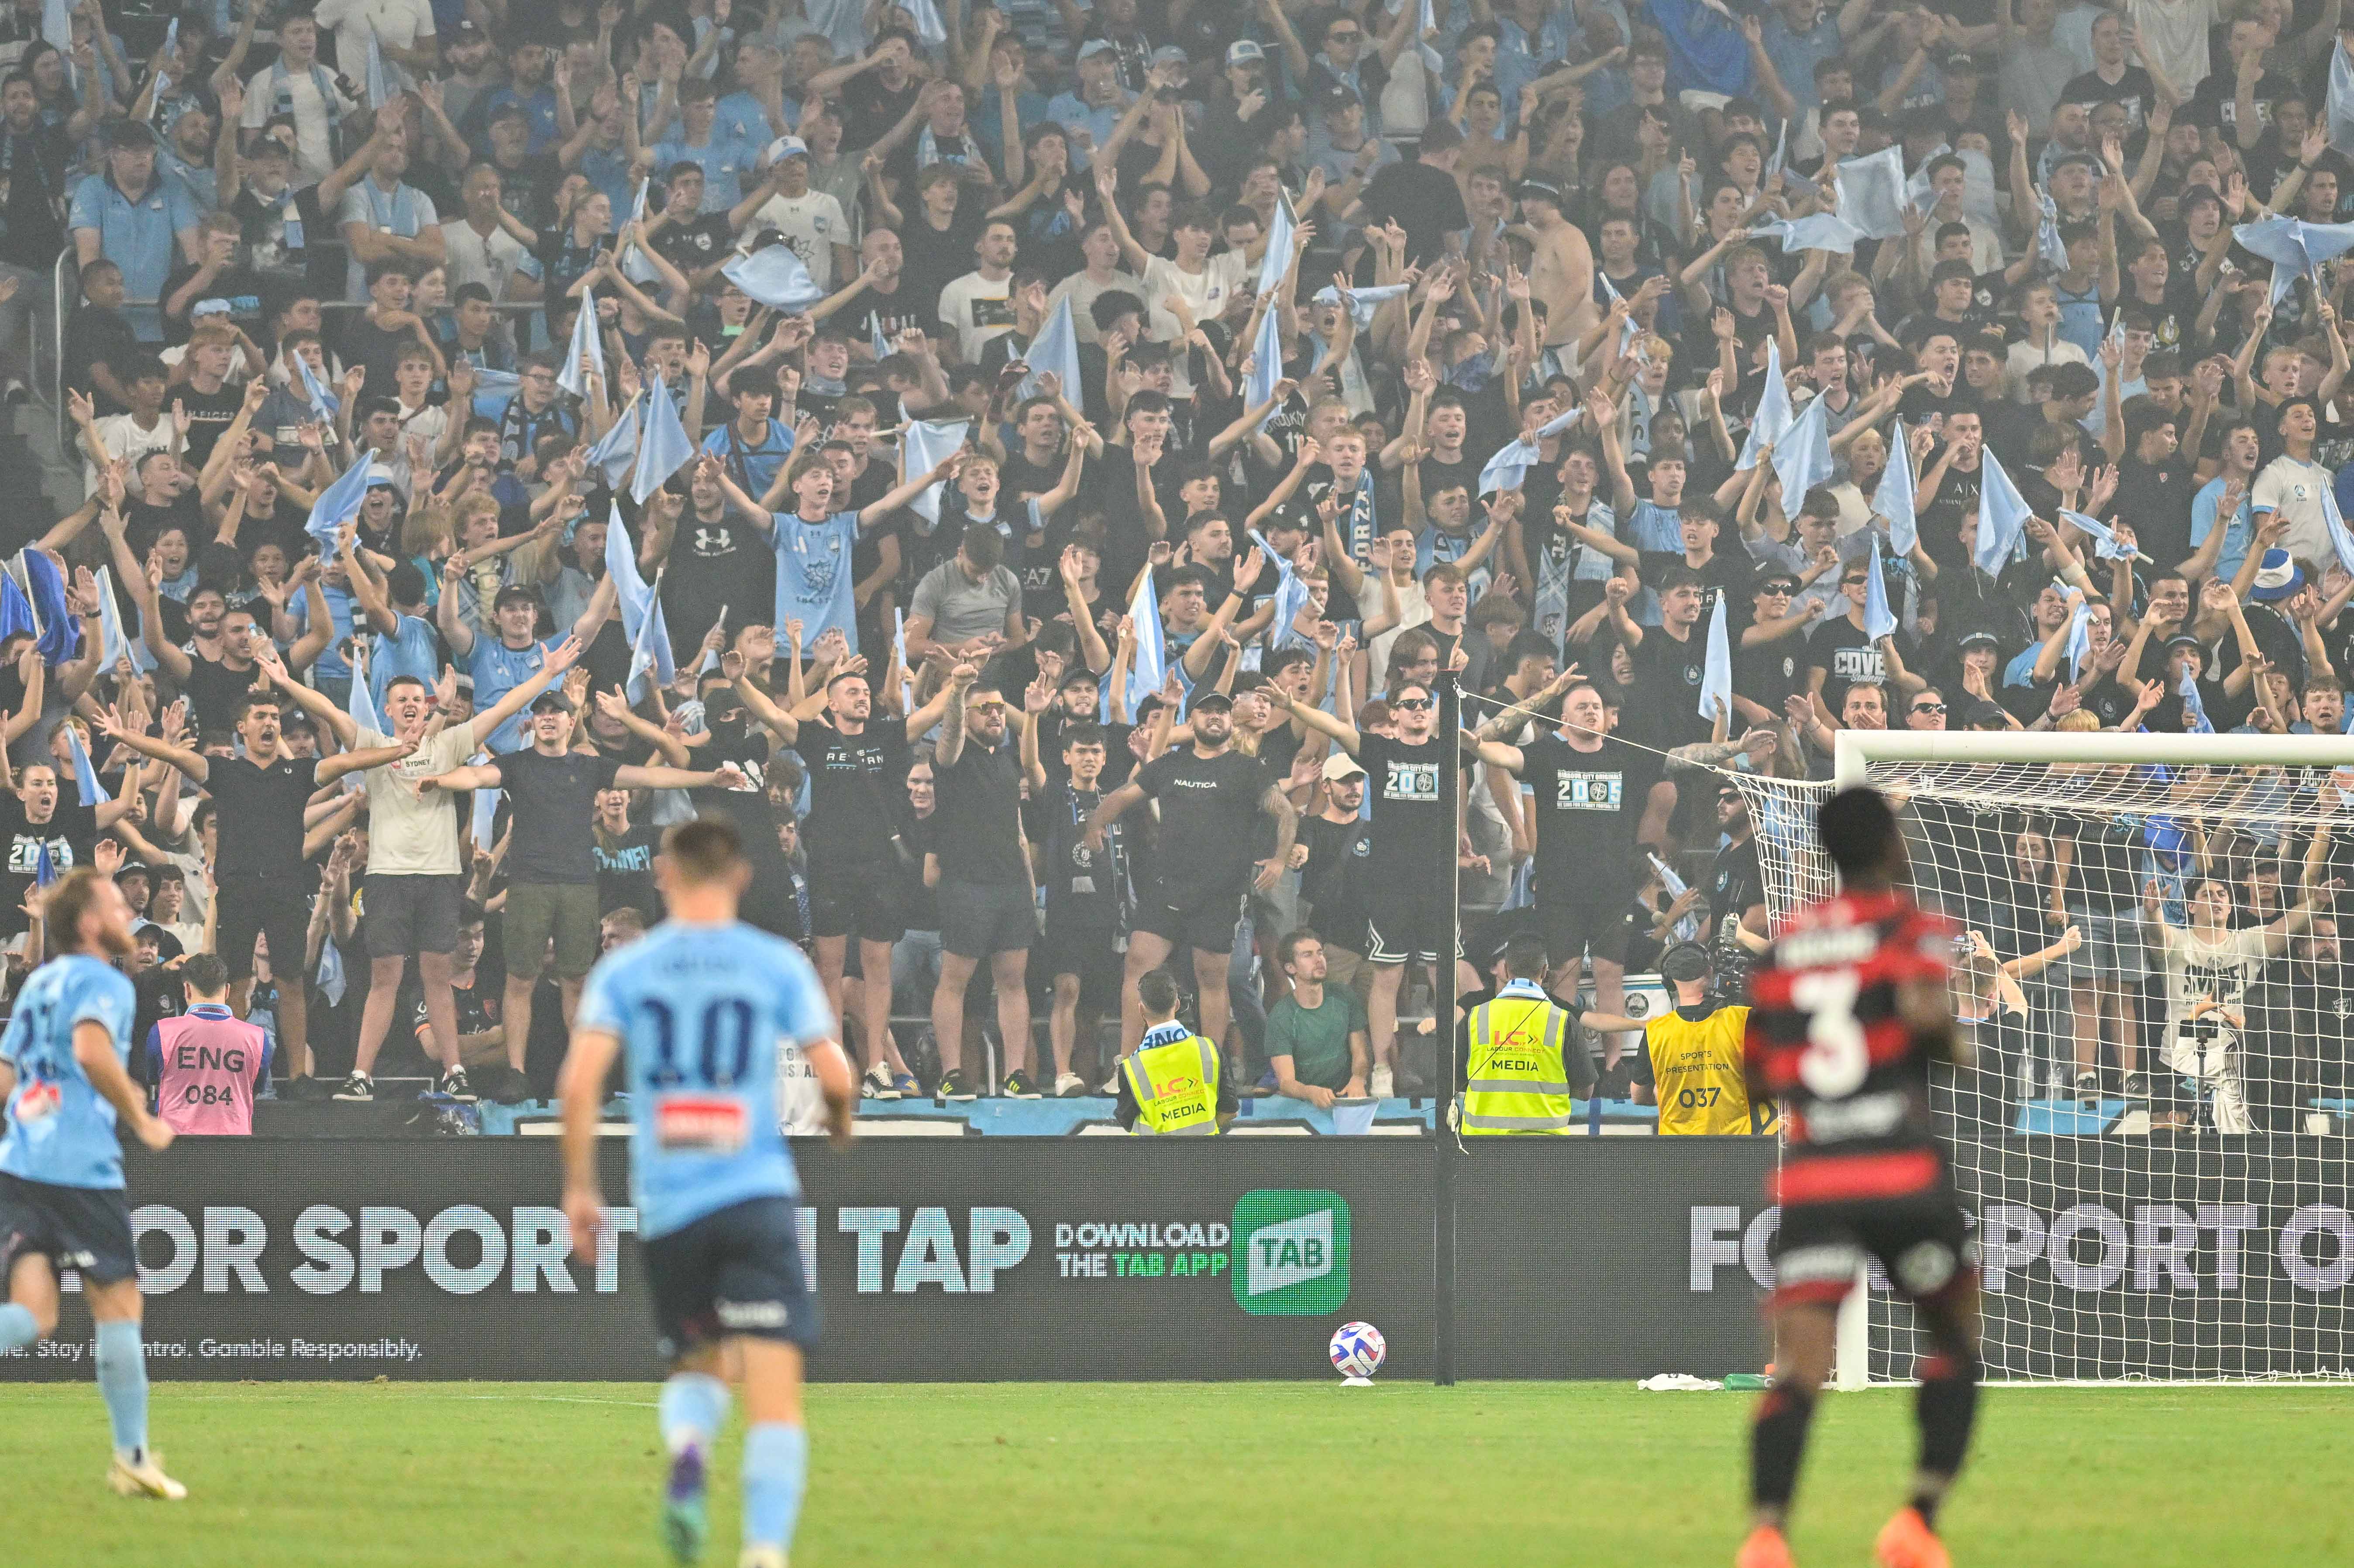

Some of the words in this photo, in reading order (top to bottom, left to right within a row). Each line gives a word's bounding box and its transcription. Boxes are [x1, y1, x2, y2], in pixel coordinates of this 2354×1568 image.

[1834, 651, 1886, 675] COVE
[406, 759, 430, 767] SYDNEY
[1174, 779, 1217, 788] NAUTICA
[642, 994, 754, 1088] 10
[1792, 968, 1869, 1099] 3
[178, 1046, 245, 1073] ENG
[1492, 1060, 1539, 1072] MEDIA
[1680, 1051, 1712, 1060] SPORTS
[1666, 1063, 1729, 1075] PRESENTATION
[185, 1085, 233, 1106] 084
[1154, 1096, 1177, 1107] LABOUR
[1679, 1087, 1721, 1109] 037
[1161, 1102, 1206, 1122] MEDIA
[1055, 1222, 1230, 1248] DOWNLOAD
[61, 1204, 268, 1294] OR
[290, 1204, 637, 1294] SPORT
[838, 1206, 1032, 1293] TAP
[1258, 1238, 1323, 1267] TAB
[1958, 1203, 2258, 1292] PORT
[1056, 1252, 1108, 1277] THE
[1113, 1252, 1165, 1277] TAB
[1170, 1252, 1230, 1277] APP
[37, 1339, 82, 1361] Stay
[200, 1339, 285, 1357] Gamble
[292, 1339, 422, 1361] Responsibly.
